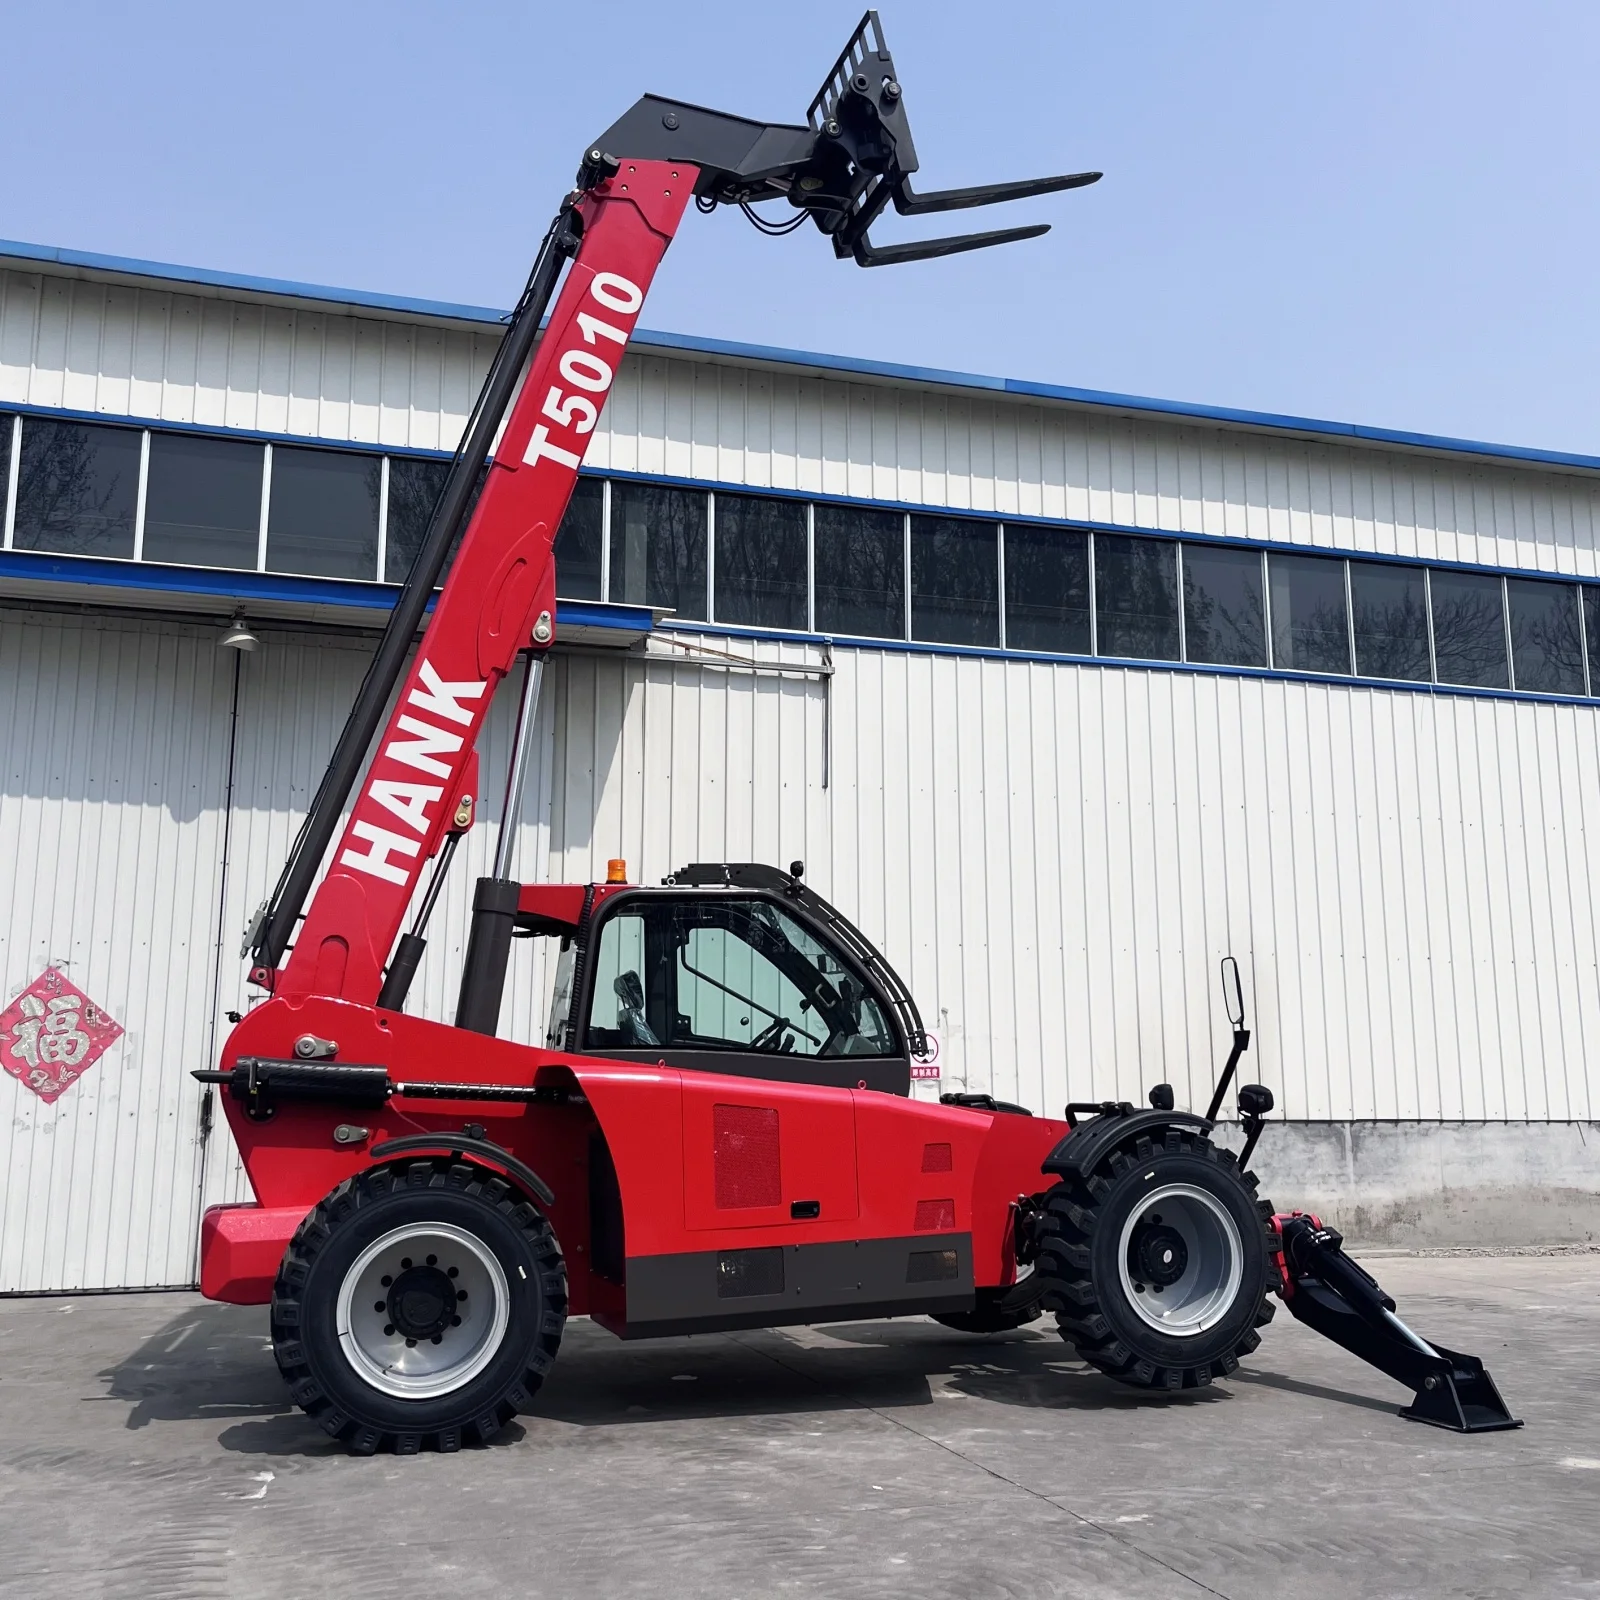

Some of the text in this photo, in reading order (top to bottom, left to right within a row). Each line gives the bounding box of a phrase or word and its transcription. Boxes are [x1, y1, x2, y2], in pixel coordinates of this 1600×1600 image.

[522, 272, 643, 470] T5010
[340, 658, 487, 886] HANK
[10, 994, 91, 1068] 福
